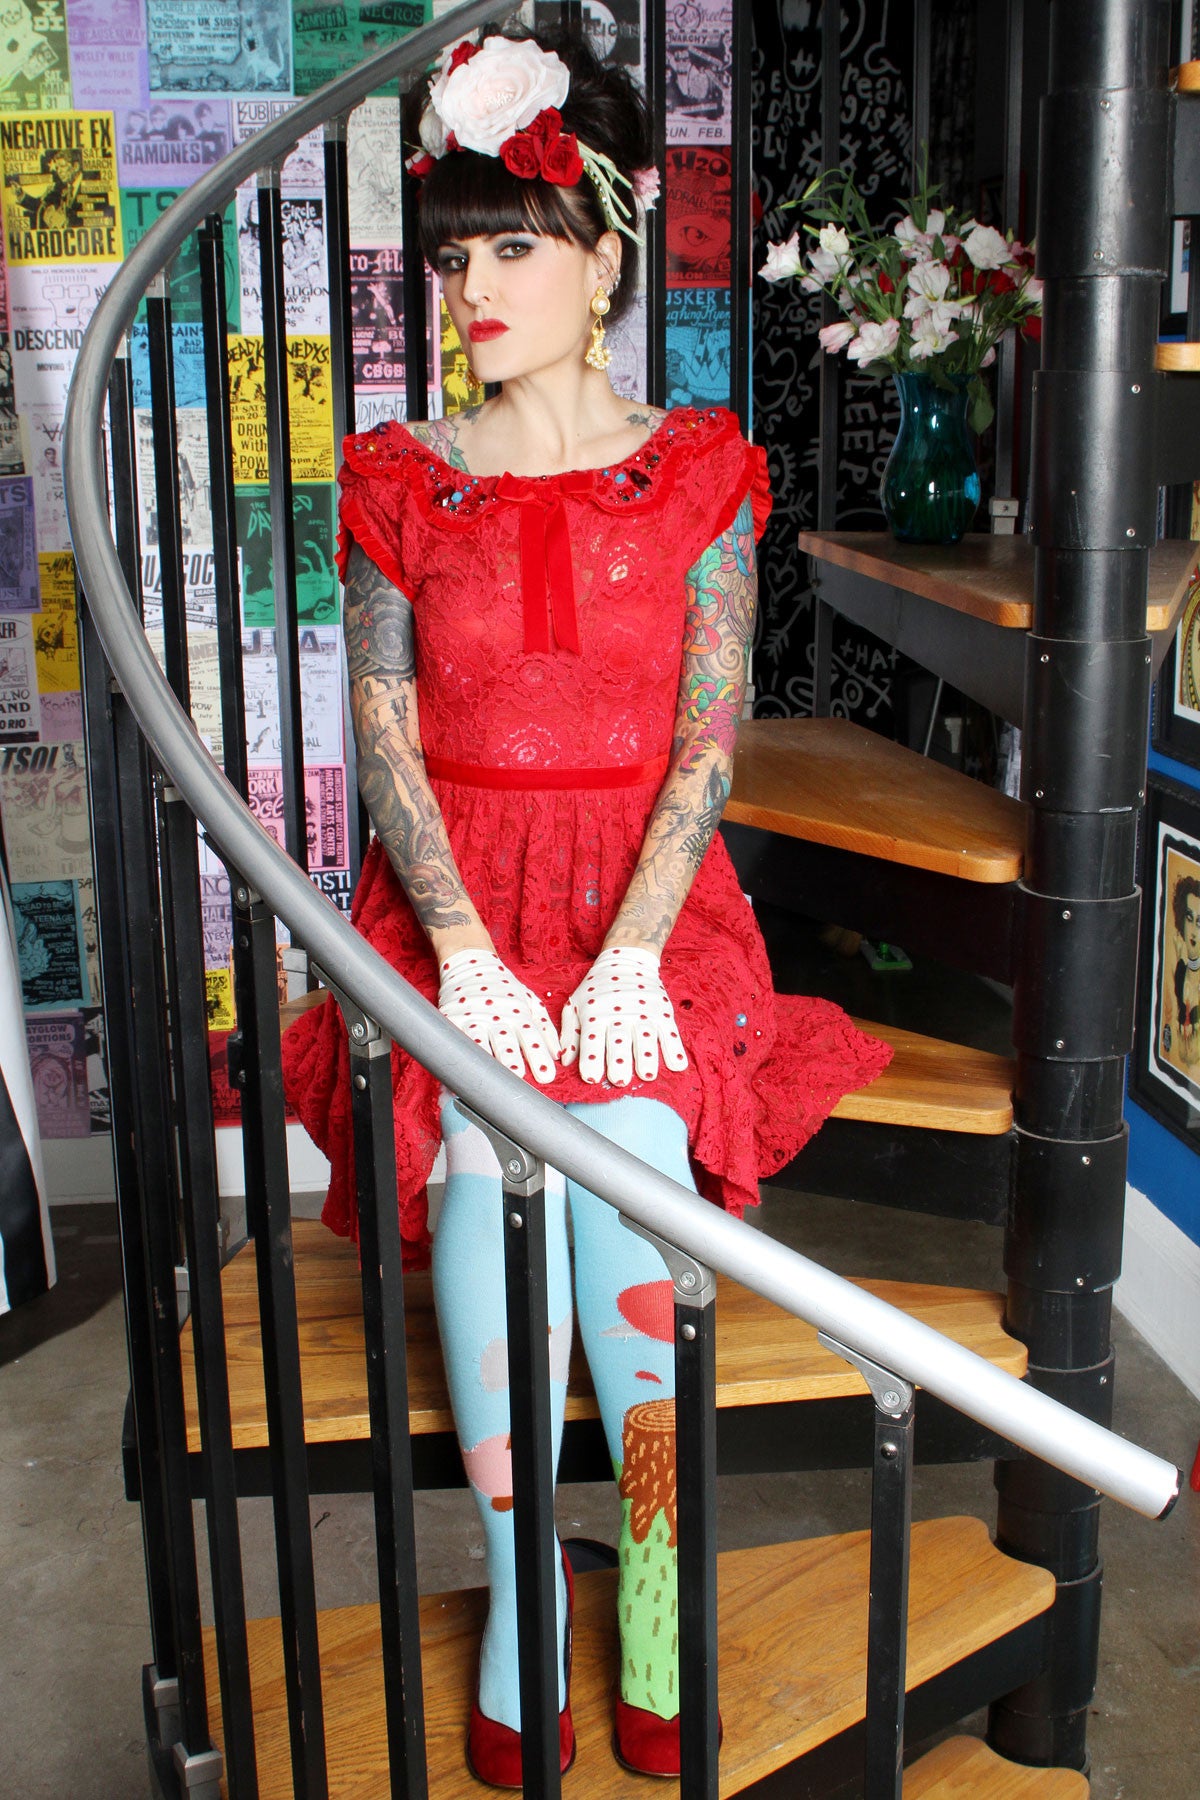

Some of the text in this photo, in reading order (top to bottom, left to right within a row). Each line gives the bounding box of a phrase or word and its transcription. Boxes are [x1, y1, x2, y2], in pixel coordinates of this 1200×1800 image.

[198, 17, 240, 27] UK SUBS
[360, 4, 424, 23] NECROS
[319, 31, 347, 42] JFA
[1, 118, 111, 149] NEGATIVE FX
[698, 127, 726, 138] FEB.
[122, 142, 200, 165] RAMONES
[5, 161, 24, 173] EAST
[83, 159, 112, 170] MARCH
[9, 228, 116, 260] HARDCORE
[1, 745, 59, 775] TSOL
[334, 770, 342, 801] ADMISSION
[325, 770, 335, 856] MERCER ARTS CENTER
